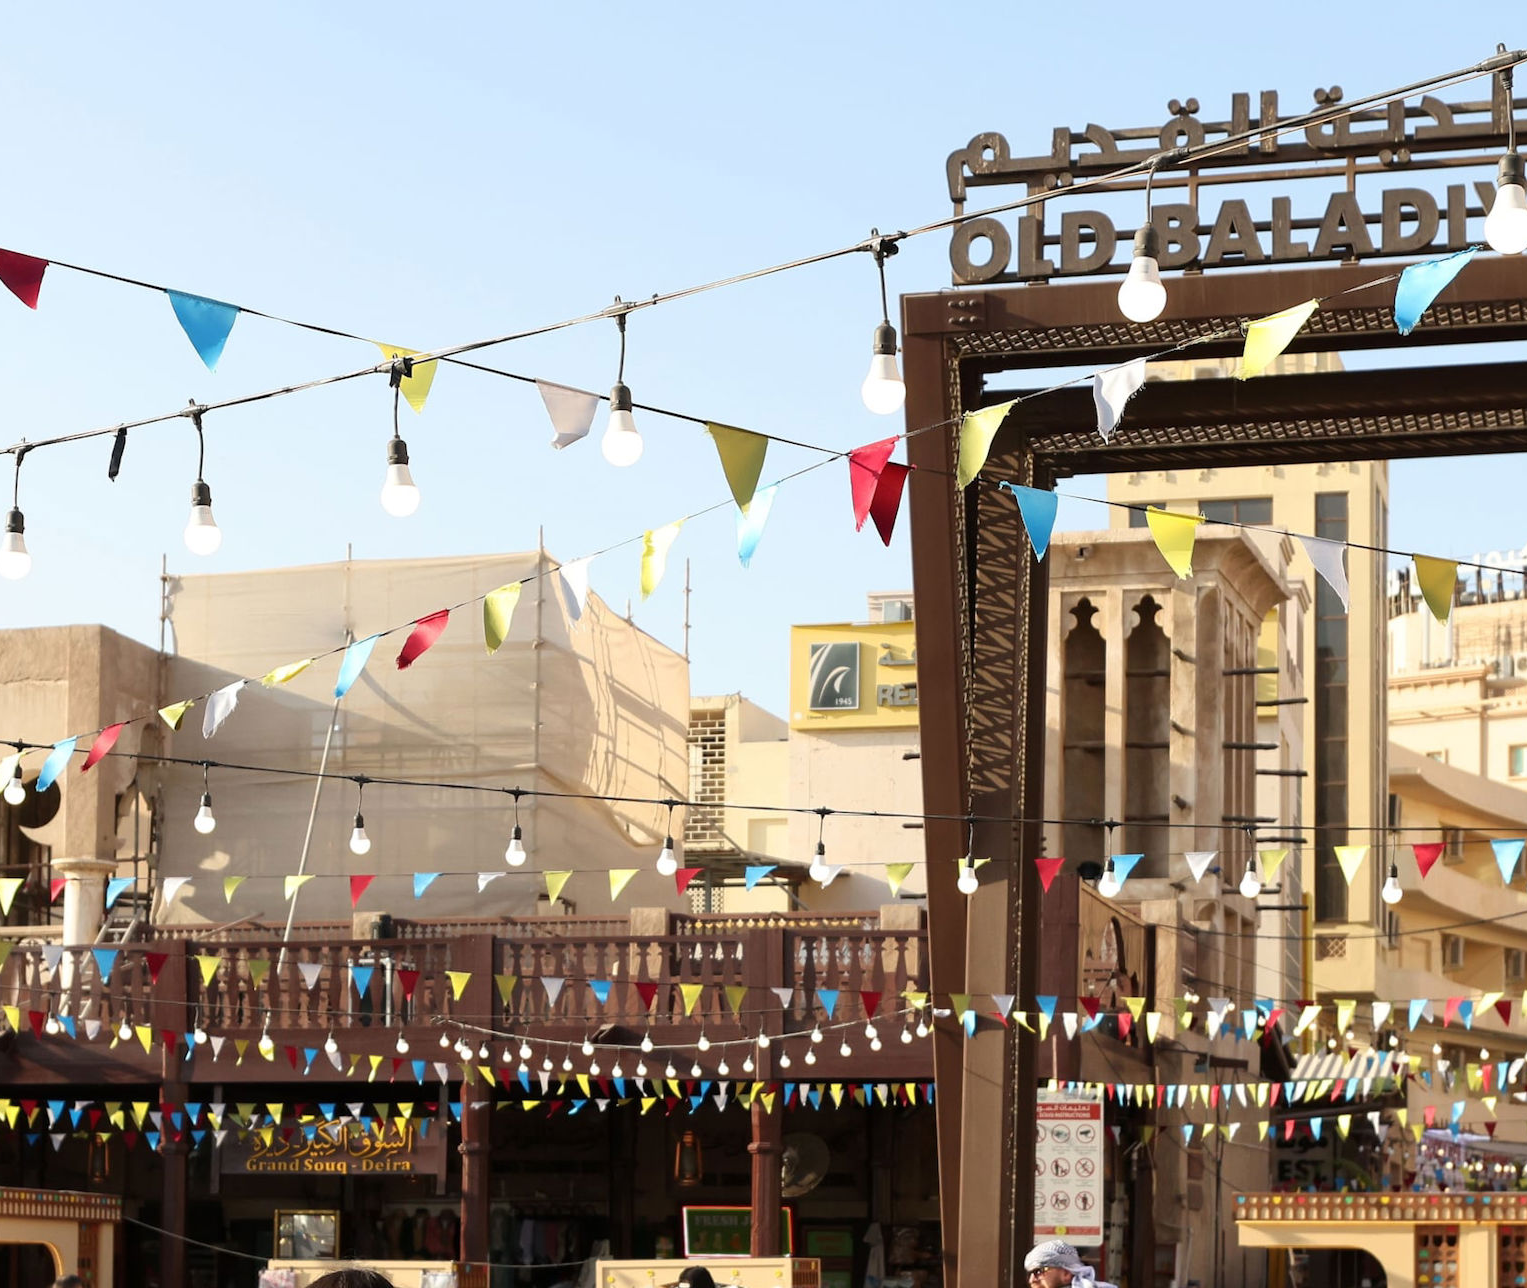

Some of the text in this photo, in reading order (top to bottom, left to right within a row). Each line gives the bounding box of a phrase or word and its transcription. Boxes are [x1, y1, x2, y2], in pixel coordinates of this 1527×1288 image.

[949, 209, 1117, 283] OLD
[835, 697, 853, 706] 1945
[246, 1158, 300, 1172] Grand
[303, 1158, 348, 1175] Souq
[361, 1158, 412, 1172] Deira
